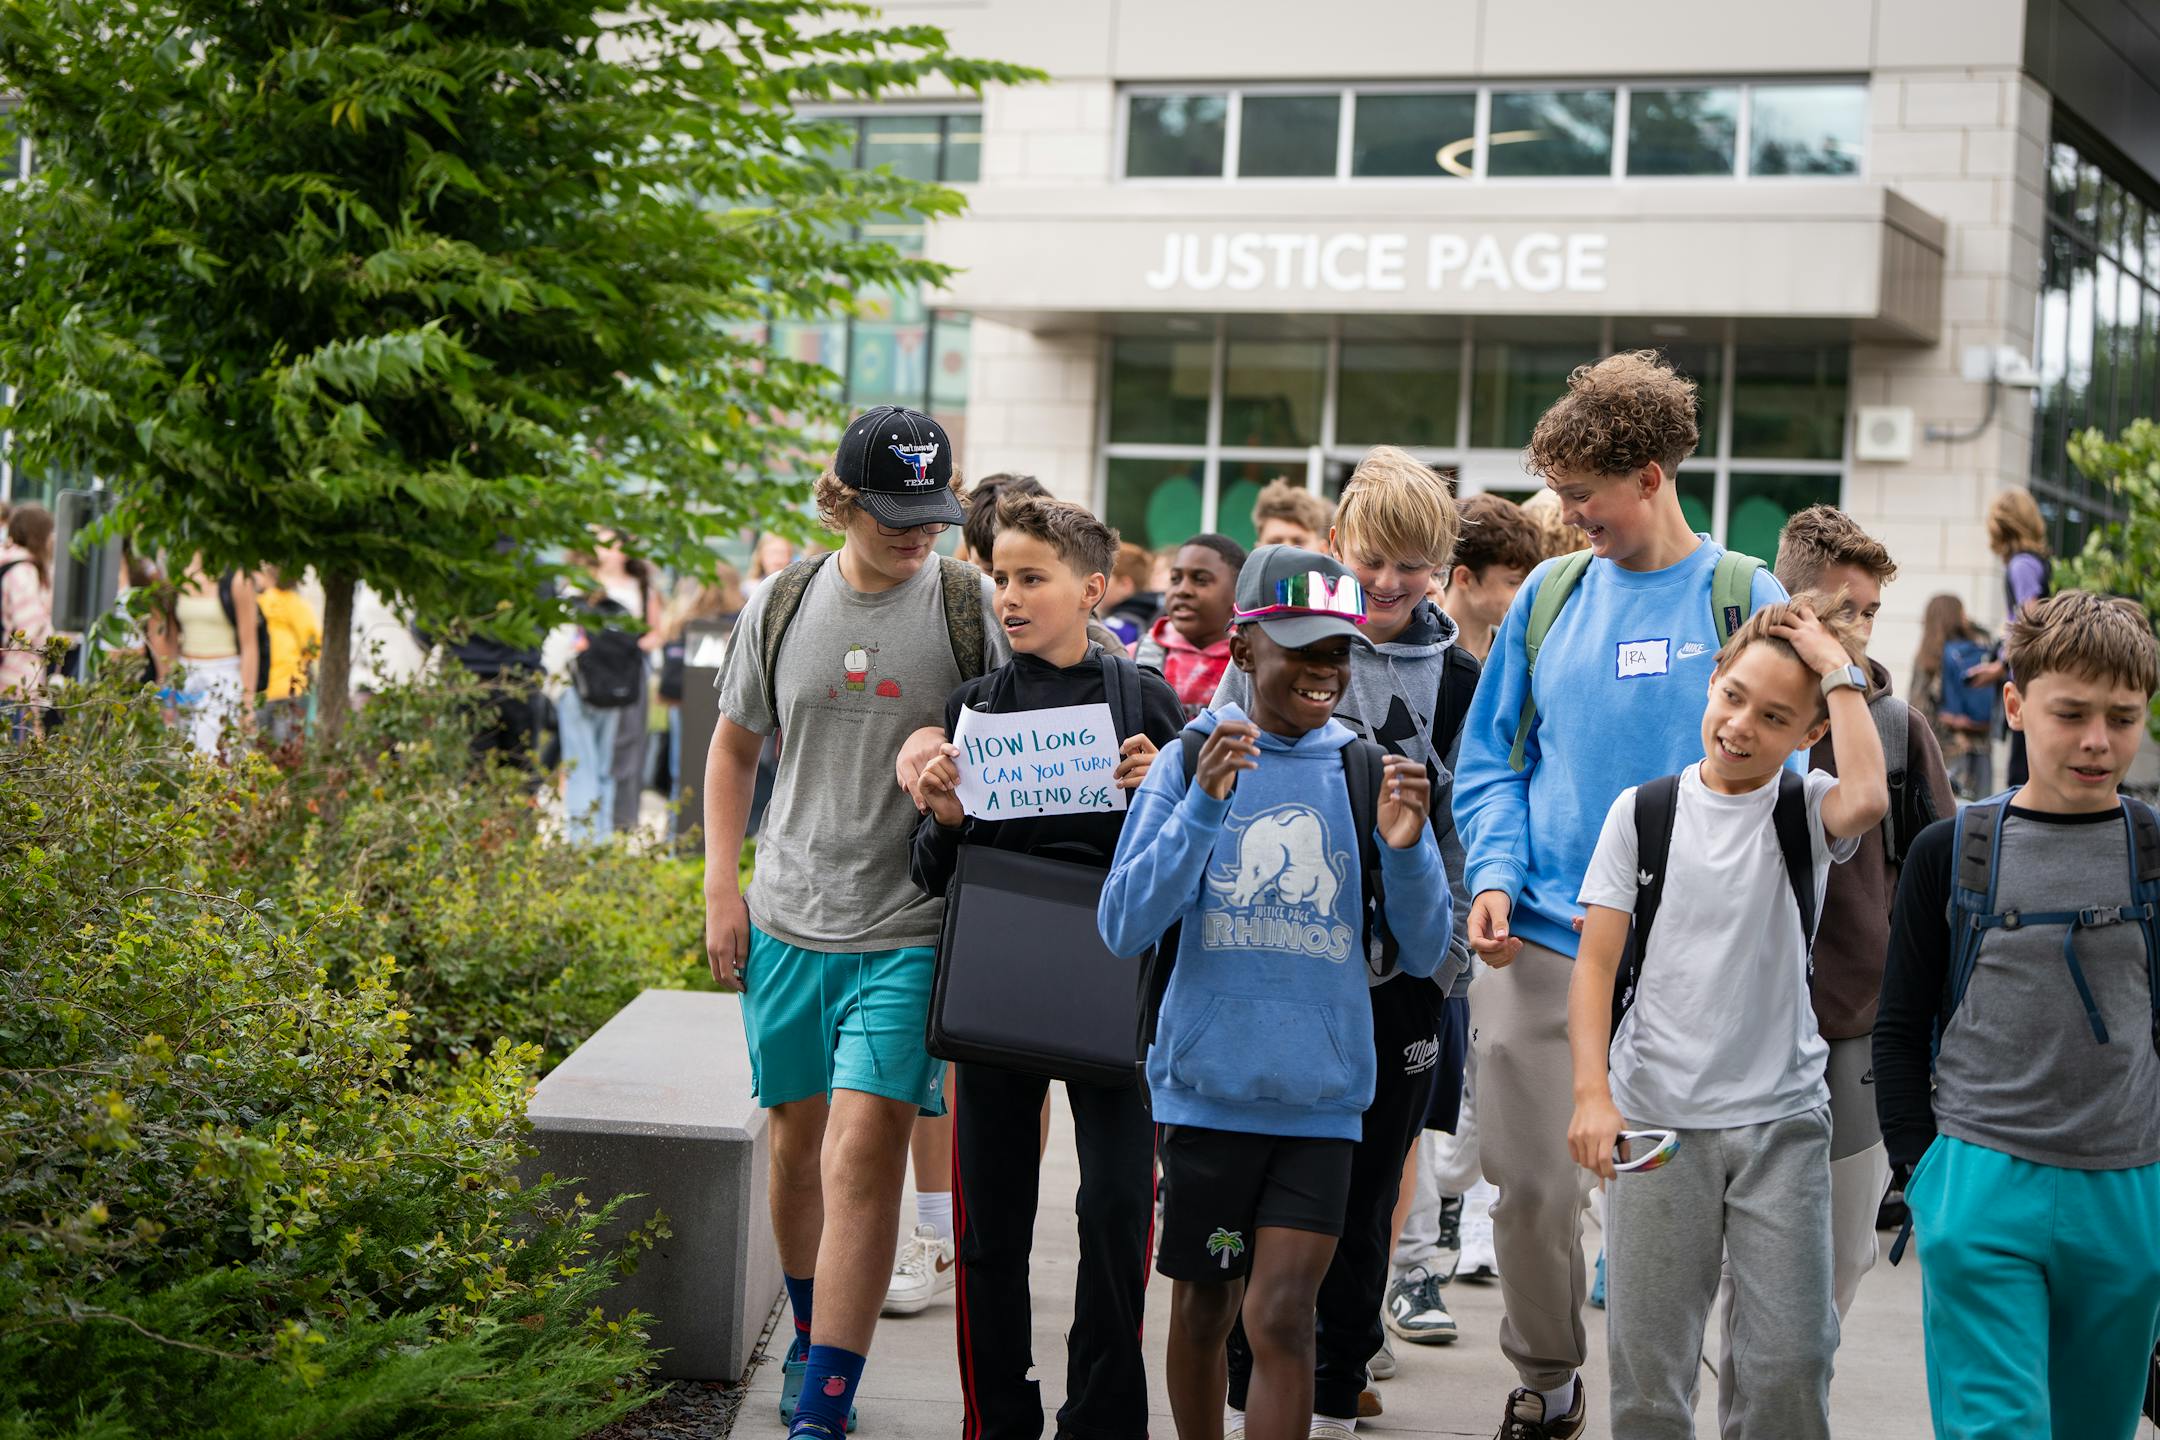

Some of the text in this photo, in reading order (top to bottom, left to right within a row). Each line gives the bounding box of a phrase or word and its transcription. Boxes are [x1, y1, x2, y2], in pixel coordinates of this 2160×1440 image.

[1146, 232, 1607, 292] JUSTICE PAGE
[904, 478, 934, 487] TEXAS
[1682, 641, 1704, 652] NIKE
[963, 728, 1096, 766] HOW LONG
[983, 756, 1113, 785] CAN YOU TURN
[987, 785, 1113, 811] A BLIND EYE
[1253, 905, 1311, 923] JUSTICE PAGE
[1204, 911, 1353, 961] RHINOS
